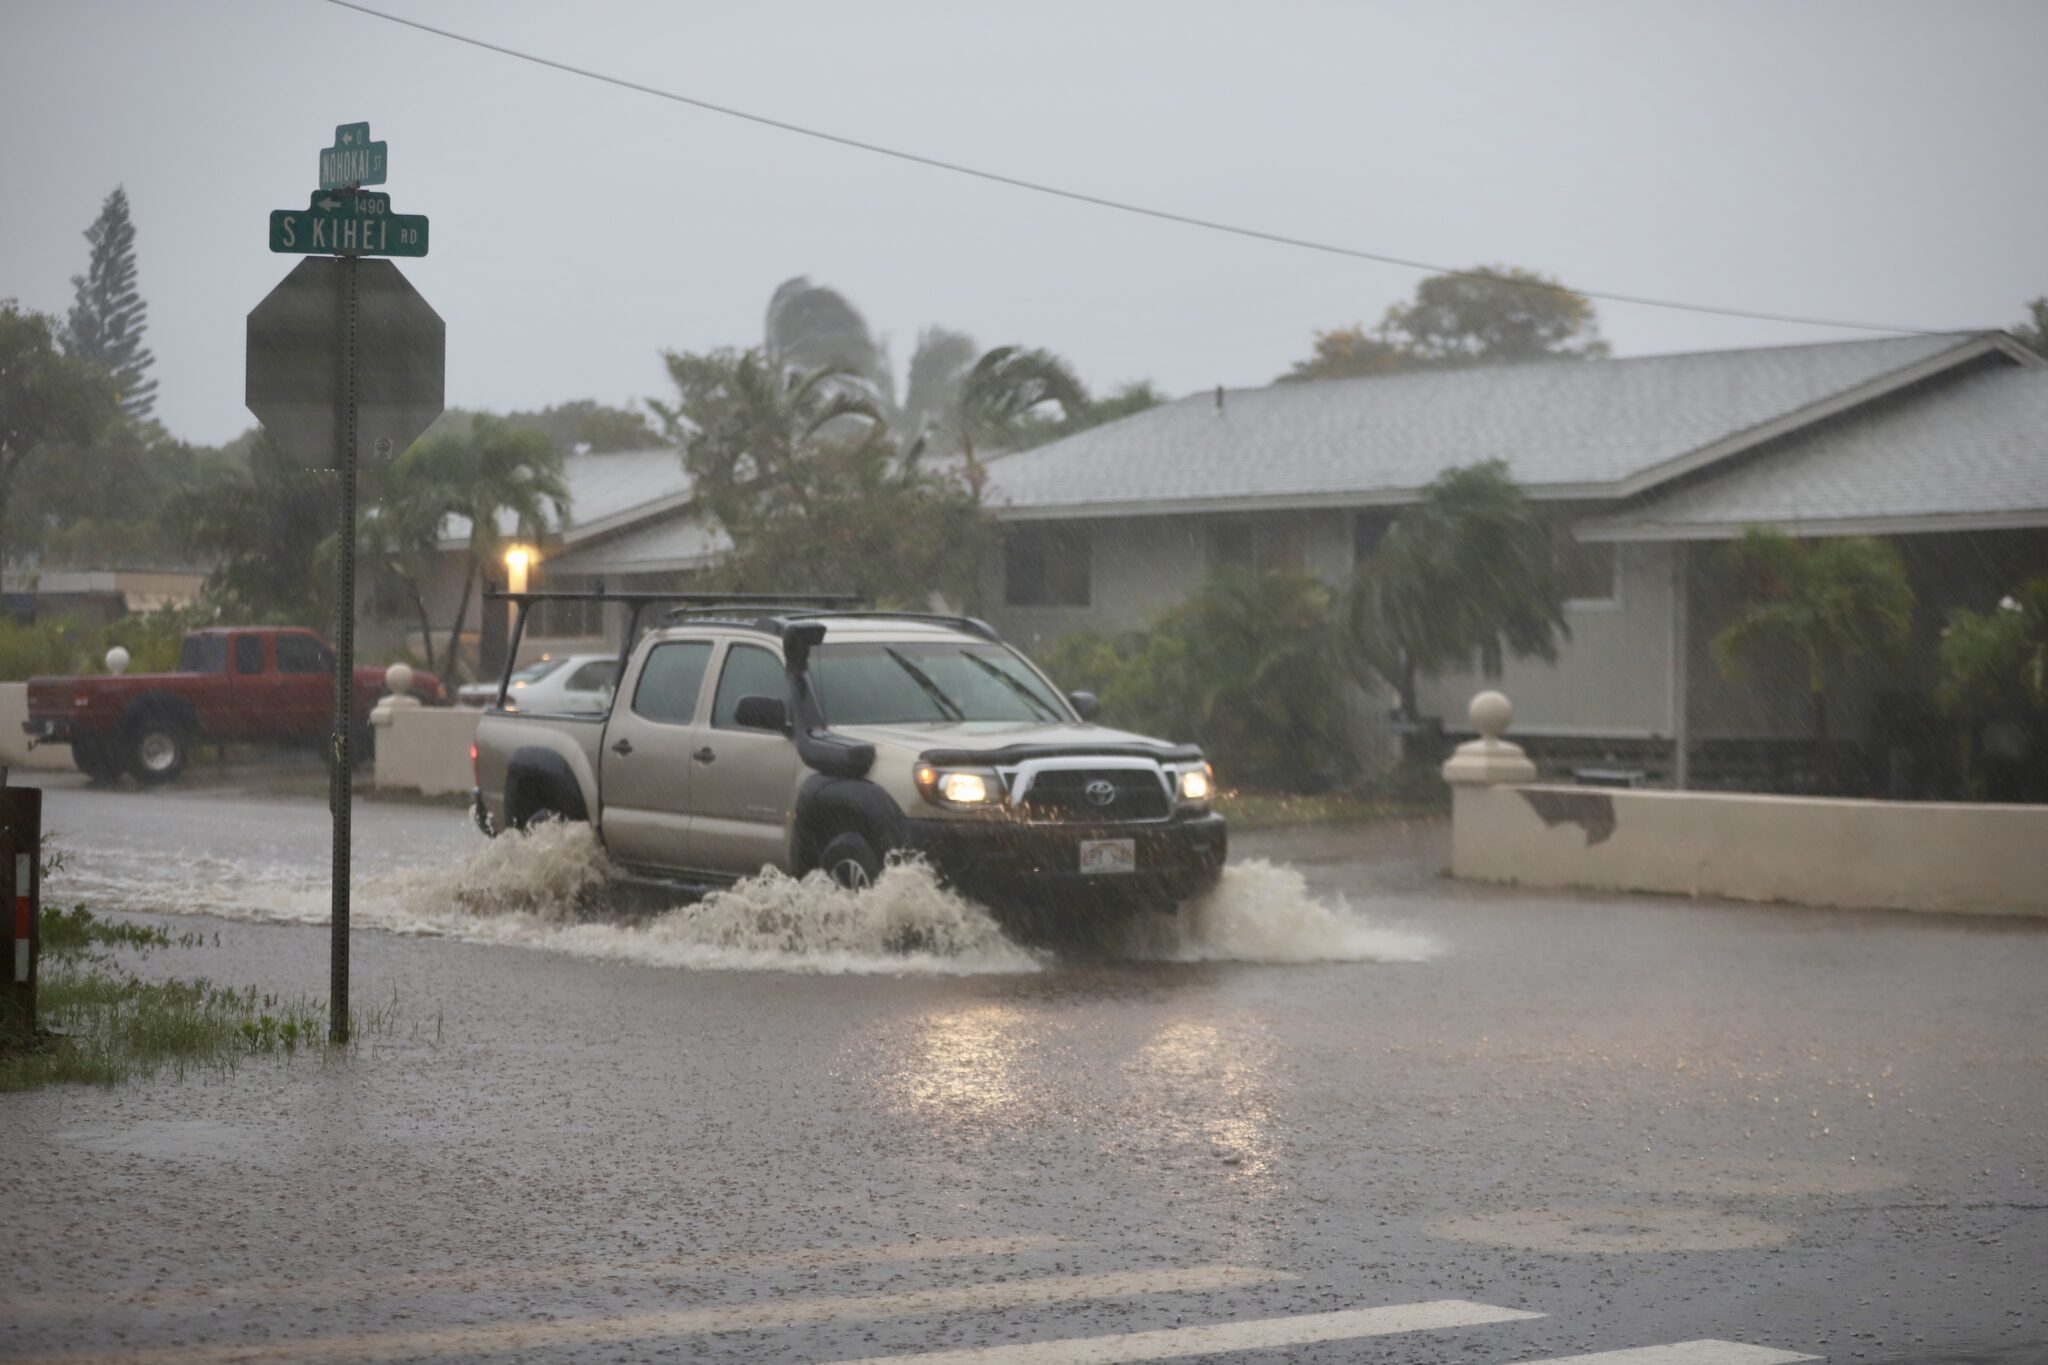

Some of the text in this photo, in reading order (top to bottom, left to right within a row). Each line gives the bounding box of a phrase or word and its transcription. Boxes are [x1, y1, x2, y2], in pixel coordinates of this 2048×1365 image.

[323, 149, 382, 184] NOHOKAI ST
[353, 197, 385, 214] 1490
[283, 216, 417, 250] S KIHEI RD
